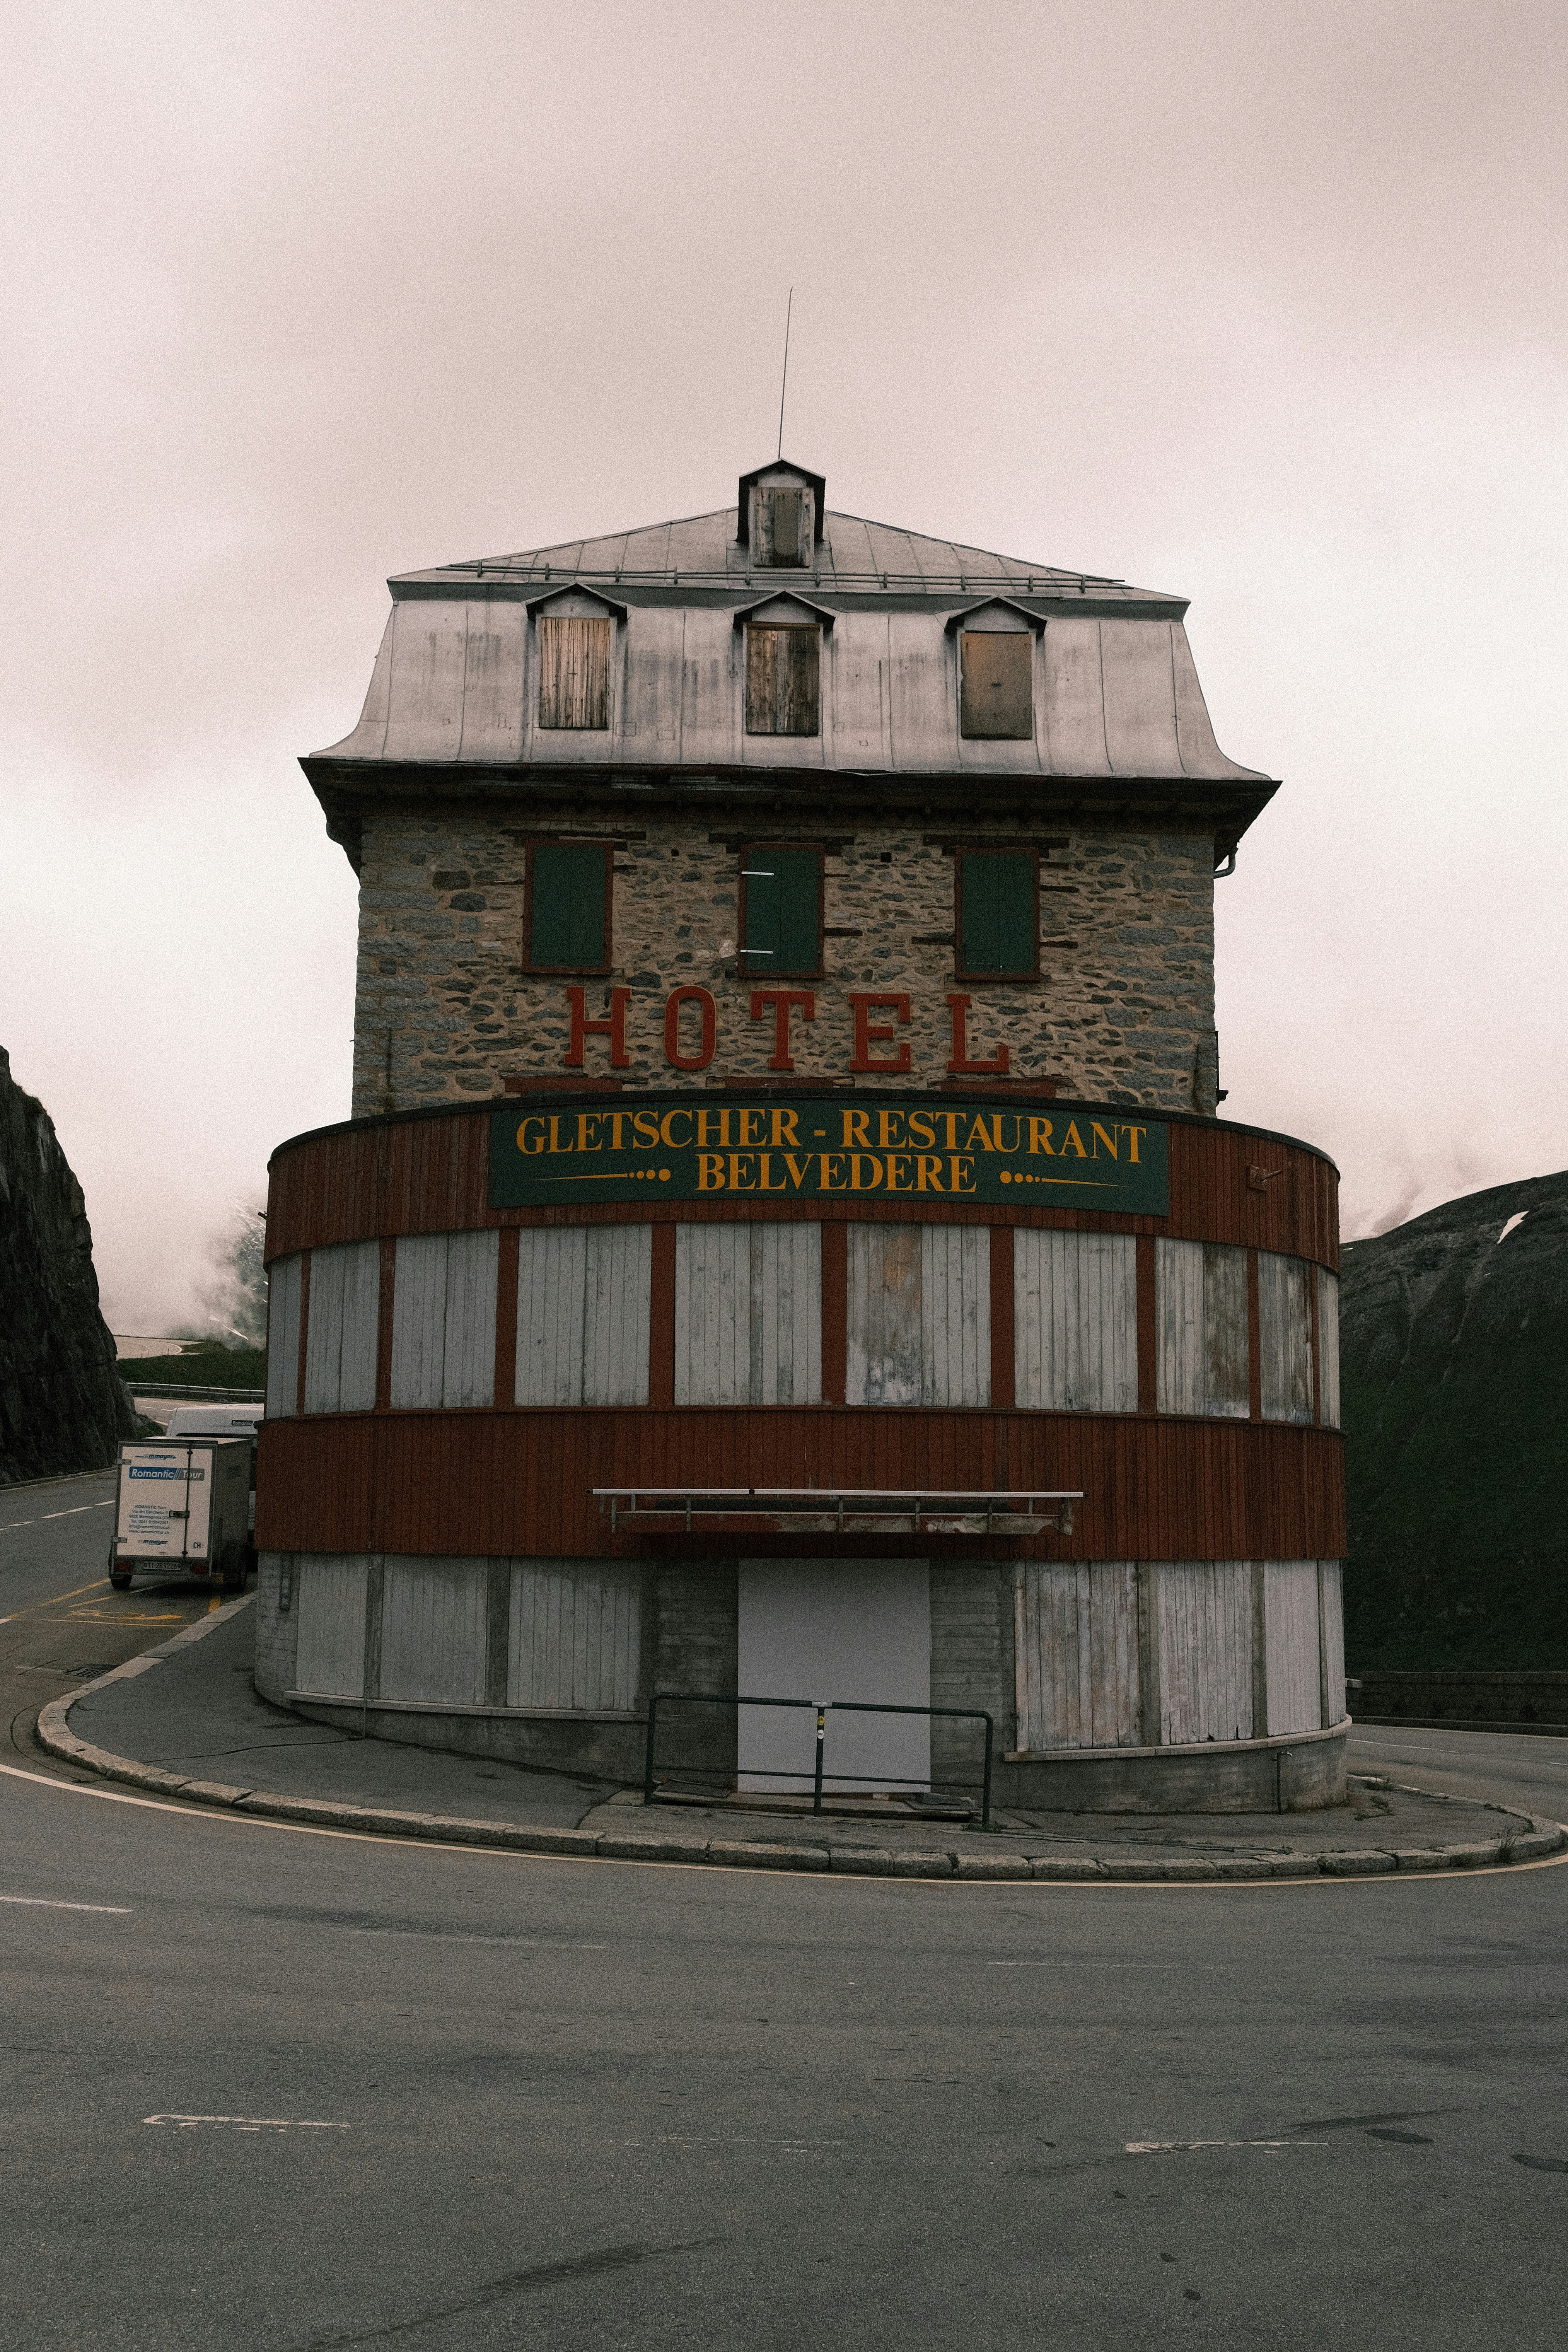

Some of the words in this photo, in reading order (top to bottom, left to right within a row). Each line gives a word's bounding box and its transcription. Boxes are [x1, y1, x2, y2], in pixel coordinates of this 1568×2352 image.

[564, 985, 1010, 1072] HOTEL
[516, 1108, 801, 1154] GLETSCHER
[841, 1109, 1147, 1163] RESTAURANT
[697, 1153, 976, 1193] BELVEDERE
[131, 1468, 174, 1478] Romantic
